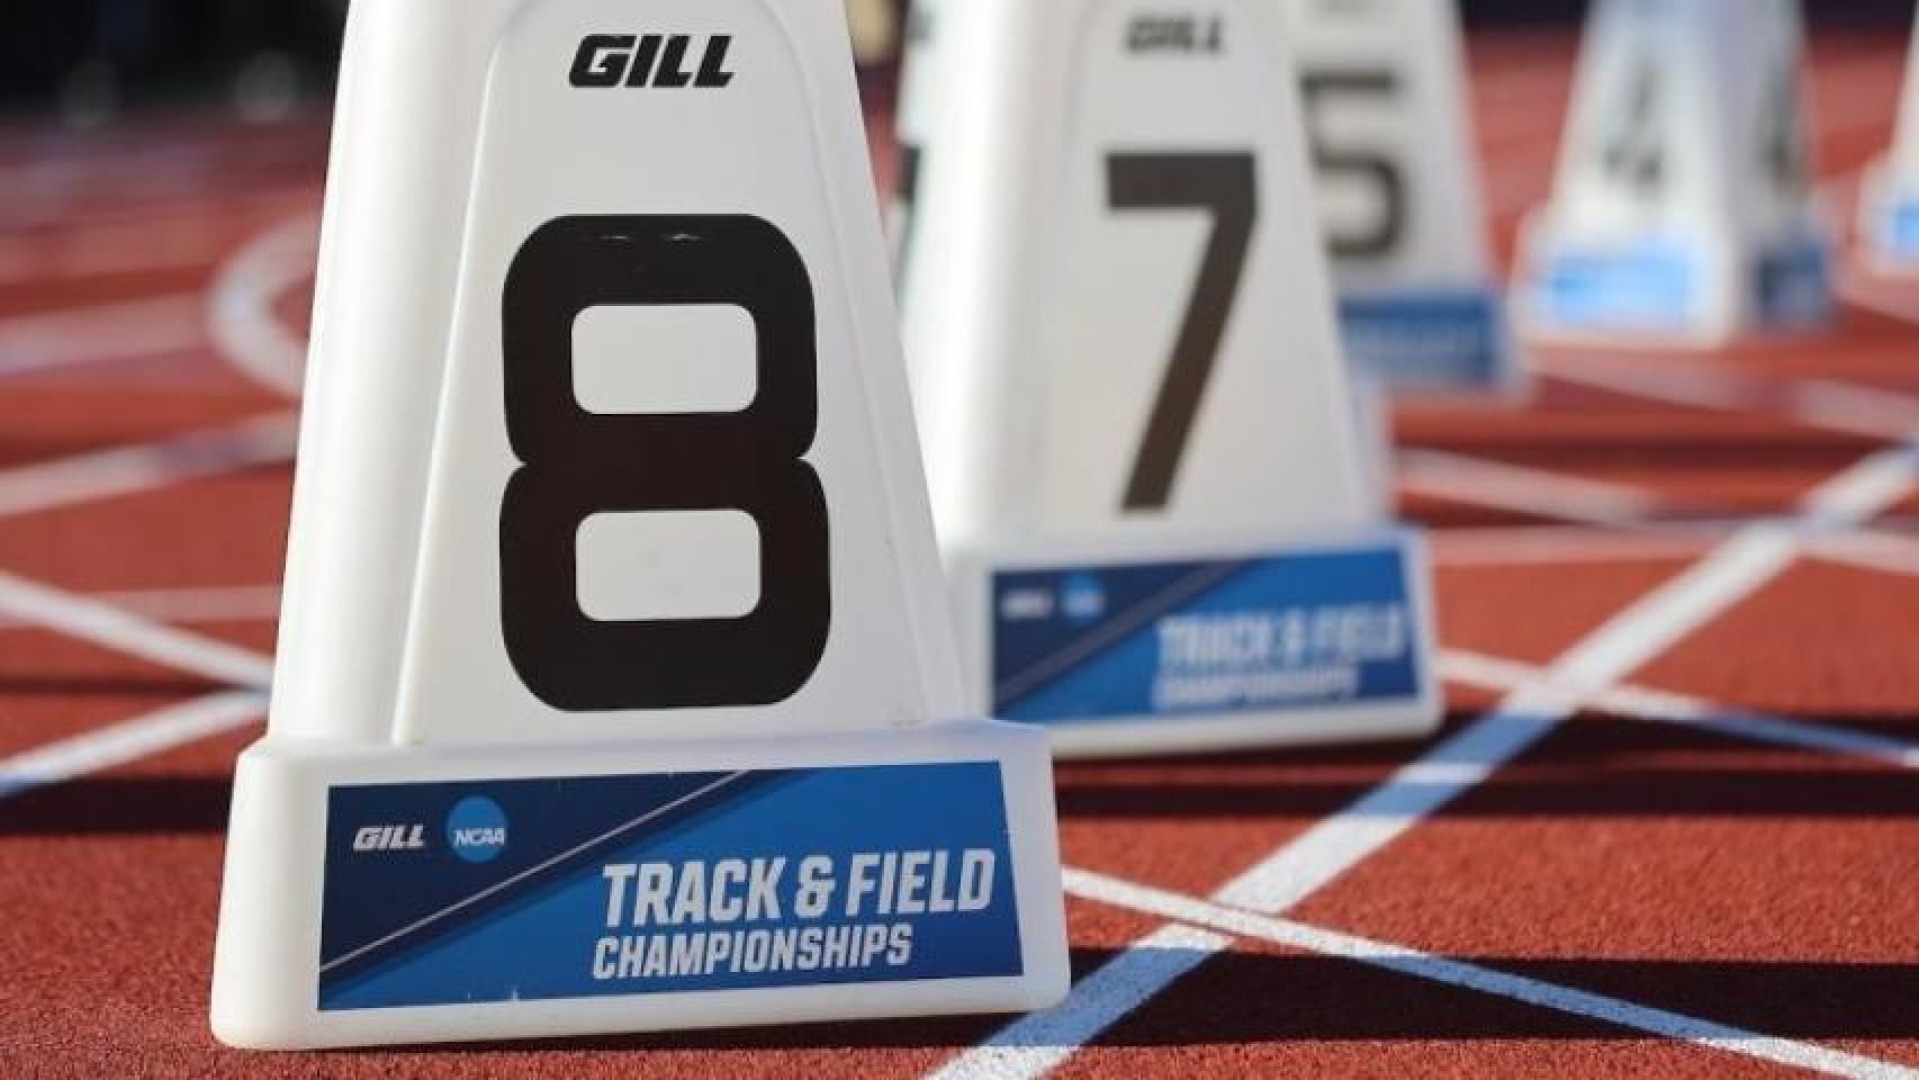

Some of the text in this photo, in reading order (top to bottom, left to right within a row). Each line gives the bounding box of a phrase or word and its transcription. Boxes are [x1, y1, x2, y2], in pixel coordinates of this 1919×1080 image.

[569, 34, 734, 88] GILL
[1300, 70, 1407, 258] 5
[1106, 152, 1257, 512] 7
[500, 213, 832, 711] 8
[352, 823, 426, 852] GILL
[453, 827, 507, 848] NCAA
[602, 847, 996, 928] TRACK & FIELD
[592, 924, 914, 980] CHAMPIONSHIPS
